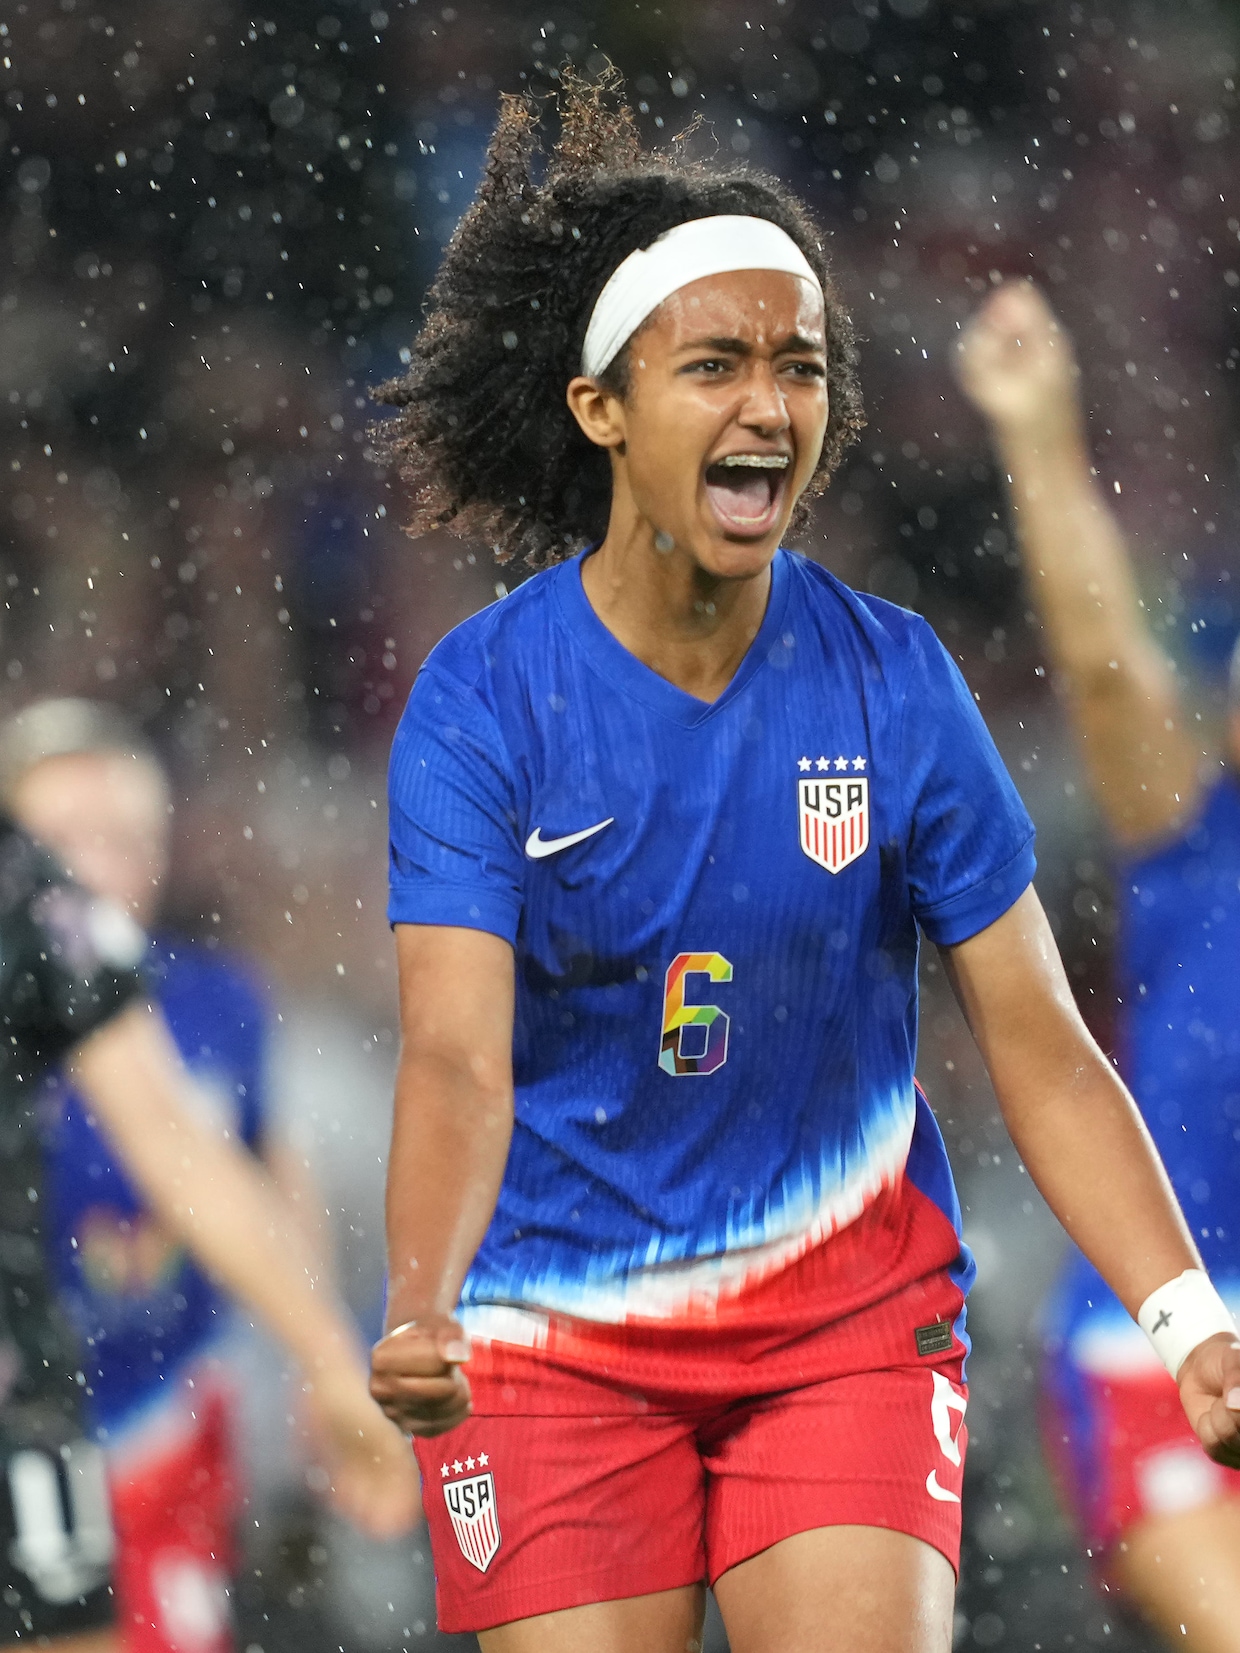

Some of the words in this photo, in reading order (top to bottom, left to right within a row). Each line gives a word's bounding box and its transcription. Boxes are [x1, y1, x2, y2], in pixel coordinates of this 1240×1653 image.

[804, 784, 863, 818] USA
[658, 951, 734, 1077] 6
[448, 1480, 490, 1518] USA
